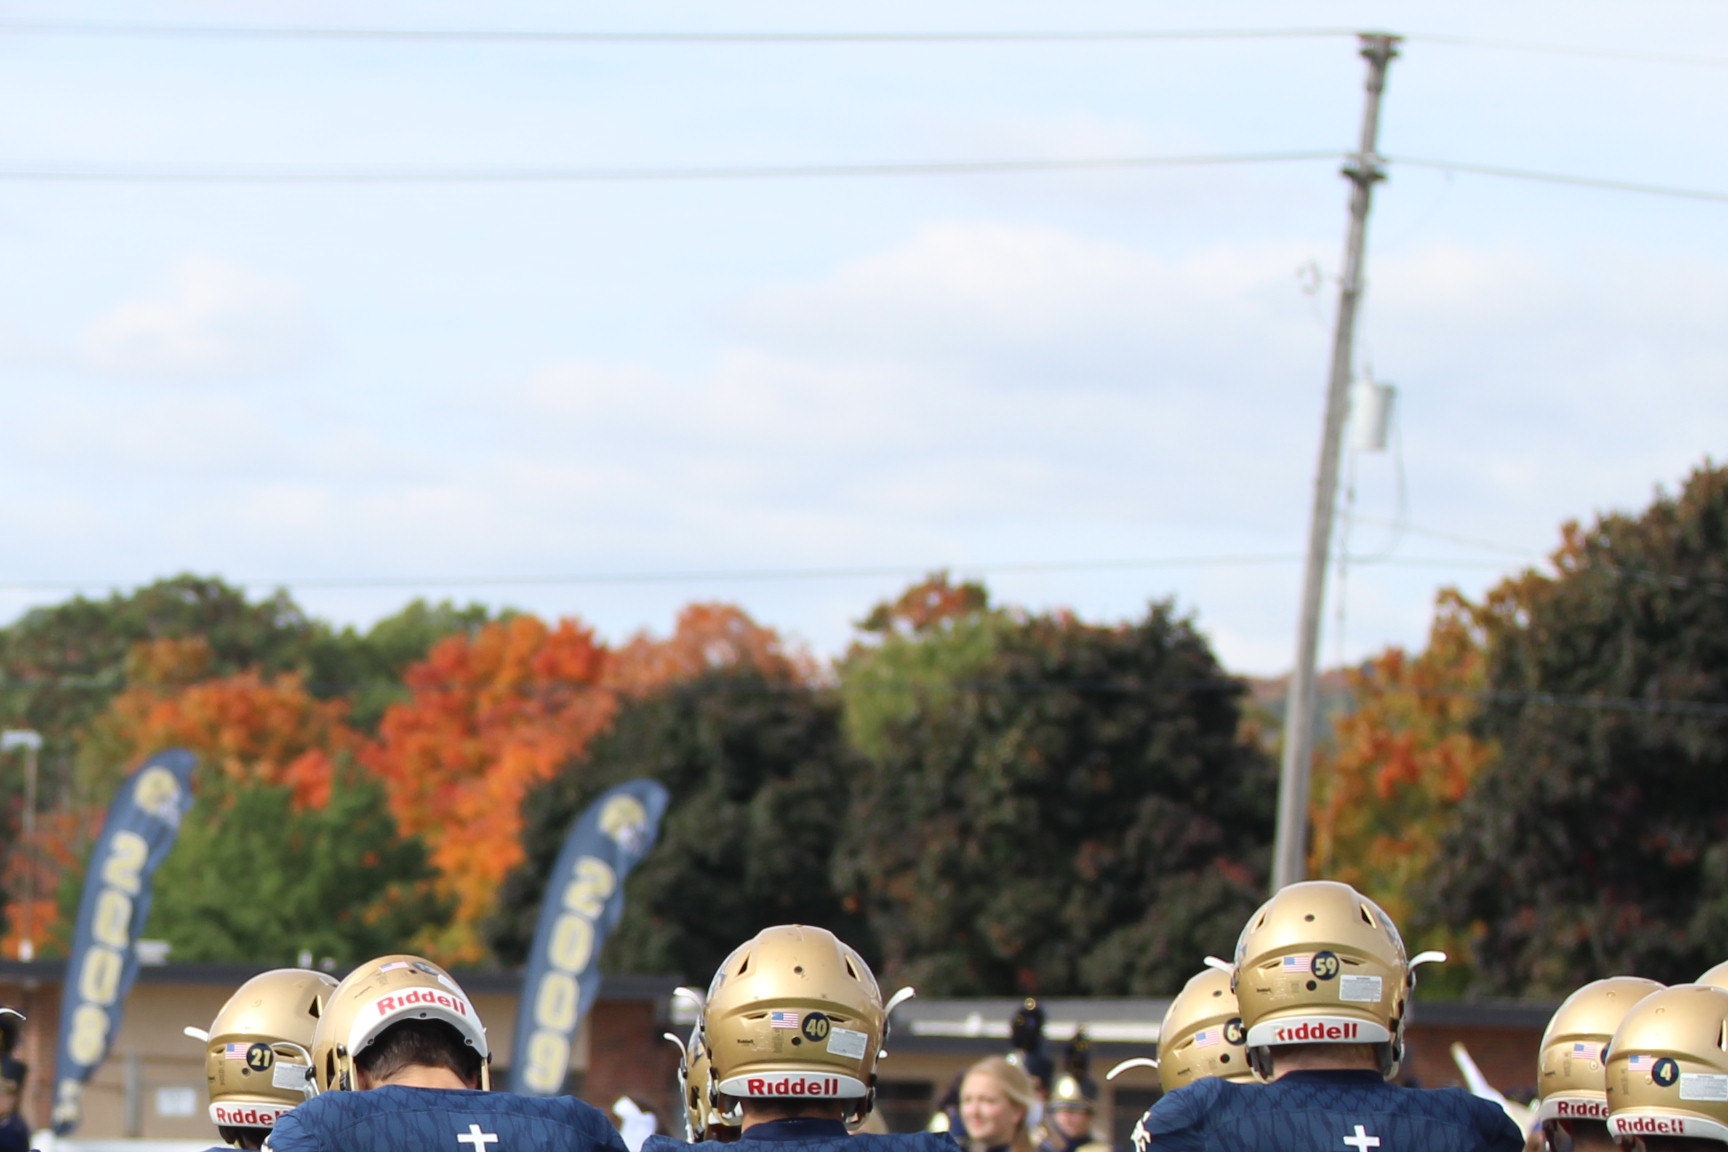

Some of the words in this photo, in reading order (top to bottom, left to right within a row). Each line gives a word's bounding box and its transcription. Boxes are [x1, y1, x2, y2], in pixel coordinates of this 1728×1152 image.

[68, 829, 148, 1066] 2008
[524, 854, 617, 1094] 2009
[1315, 956, 1337, 976] 59
[376, 990, 467, 1017] Riddell
[805, 1018, 828, 1037] 40
[251, 1047, 271, 1067] 21
[1659, 1062, 1672, 1081] 4
[747, 1078, 839, 1096] Riddell
[1558, 1101, 1610, 1118] Ridde
[1616, 1118, 1685, 1134] Riddell
